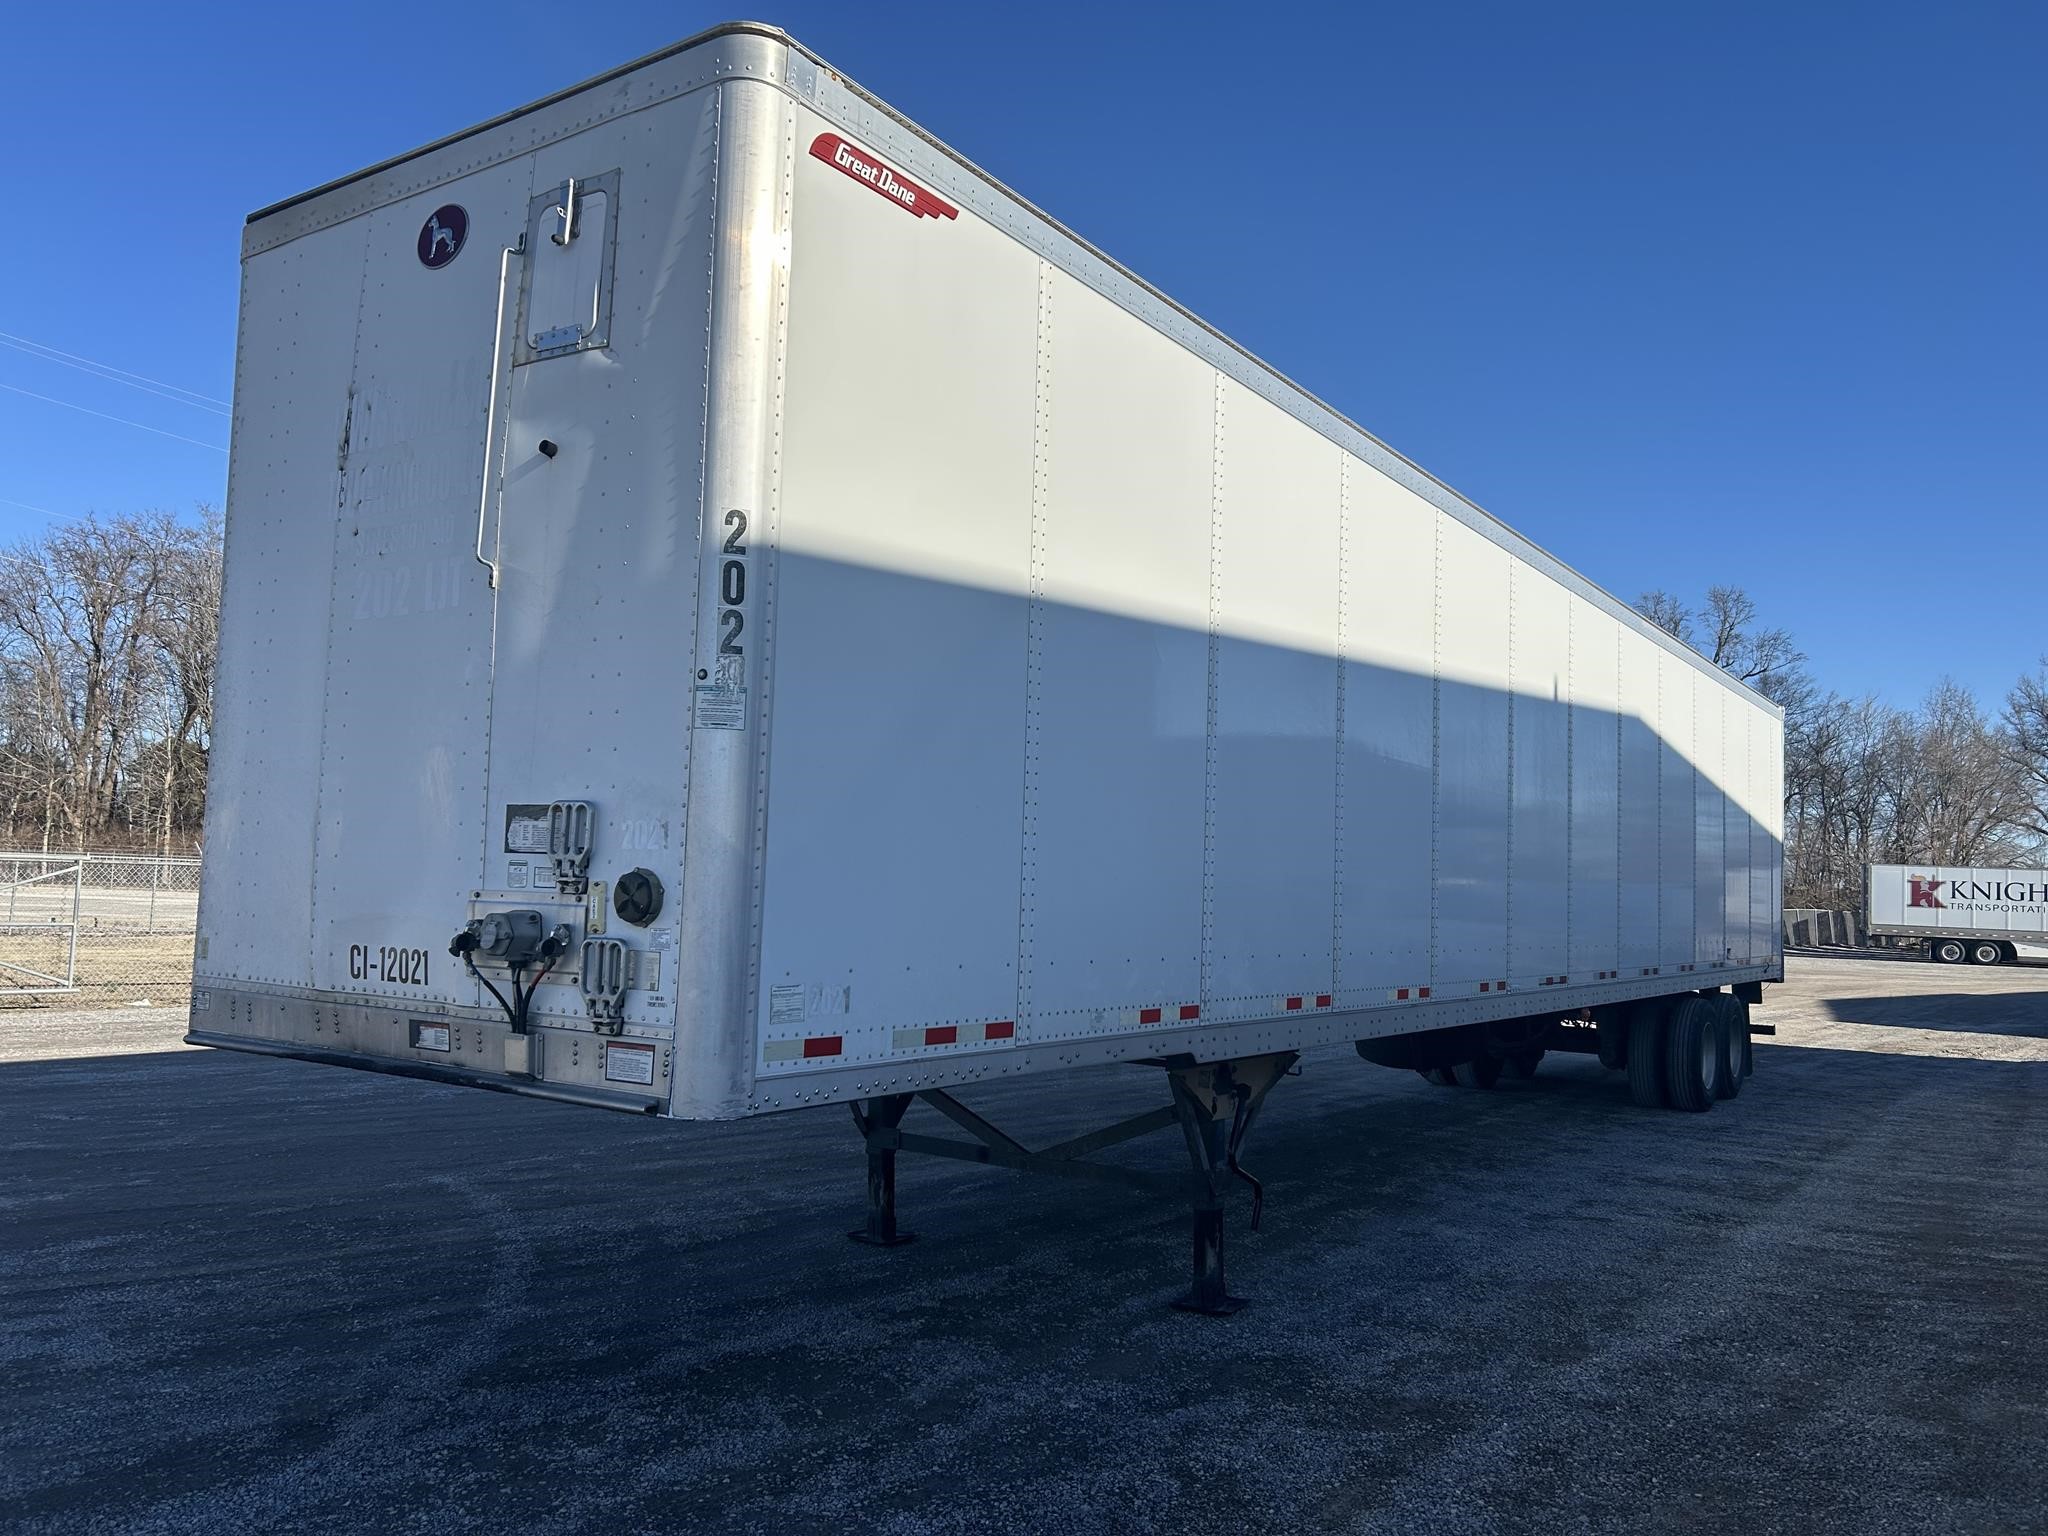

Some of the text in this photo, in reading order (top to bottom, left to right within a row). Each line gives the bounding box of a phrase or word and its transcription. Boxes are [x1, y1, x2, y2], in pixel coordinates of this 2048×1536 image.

[834, 142, 916, 206] Great Dane
[350, 944, 429, 986] CI-12021
